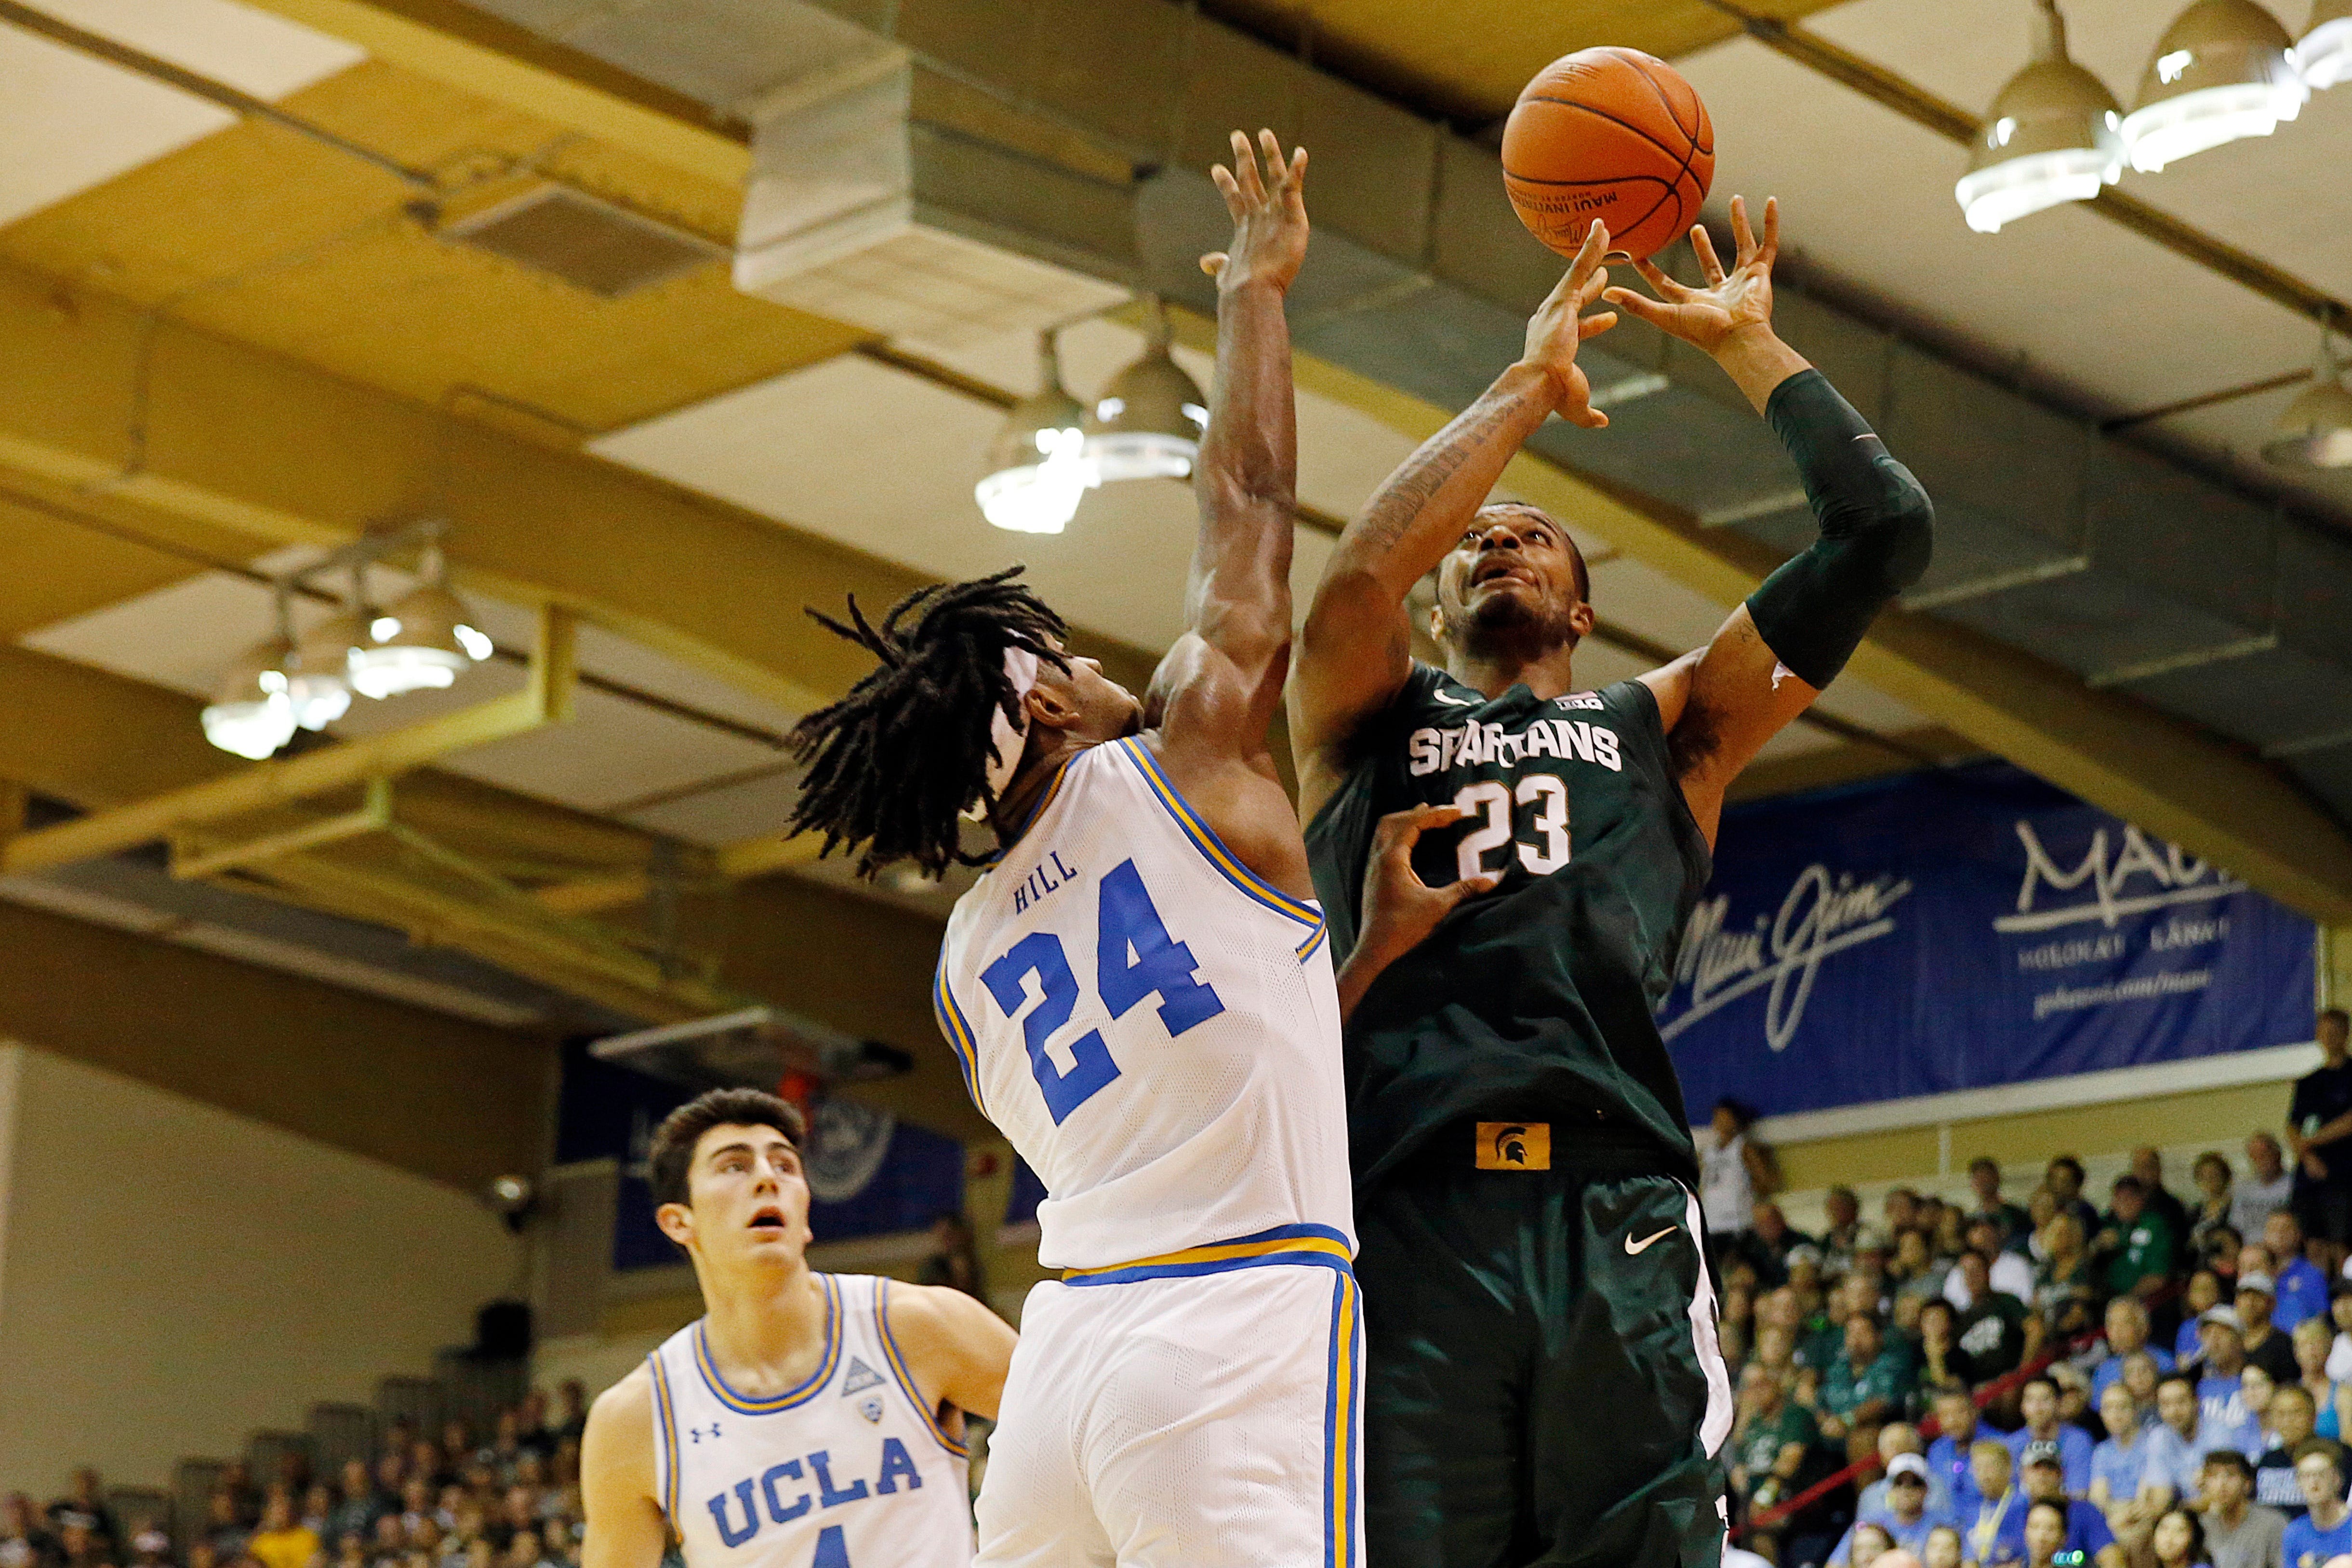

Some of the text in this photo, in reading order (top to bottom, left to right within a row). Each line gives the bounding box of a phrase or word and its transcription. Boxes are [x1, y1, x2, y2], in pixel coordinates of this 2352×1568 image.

[1575, 191, 1618, 212] MAUI
[1409, 718, 1623, 777] SPARTANS
[1013, 850, 1078, 915] HILL
[1453, 772, 1572, 885] 23
[2015, 819, 2231, 929] MAU
[978, 857, 1226, 1127] 24
[706, 1436, 922, 1548] UCLA
